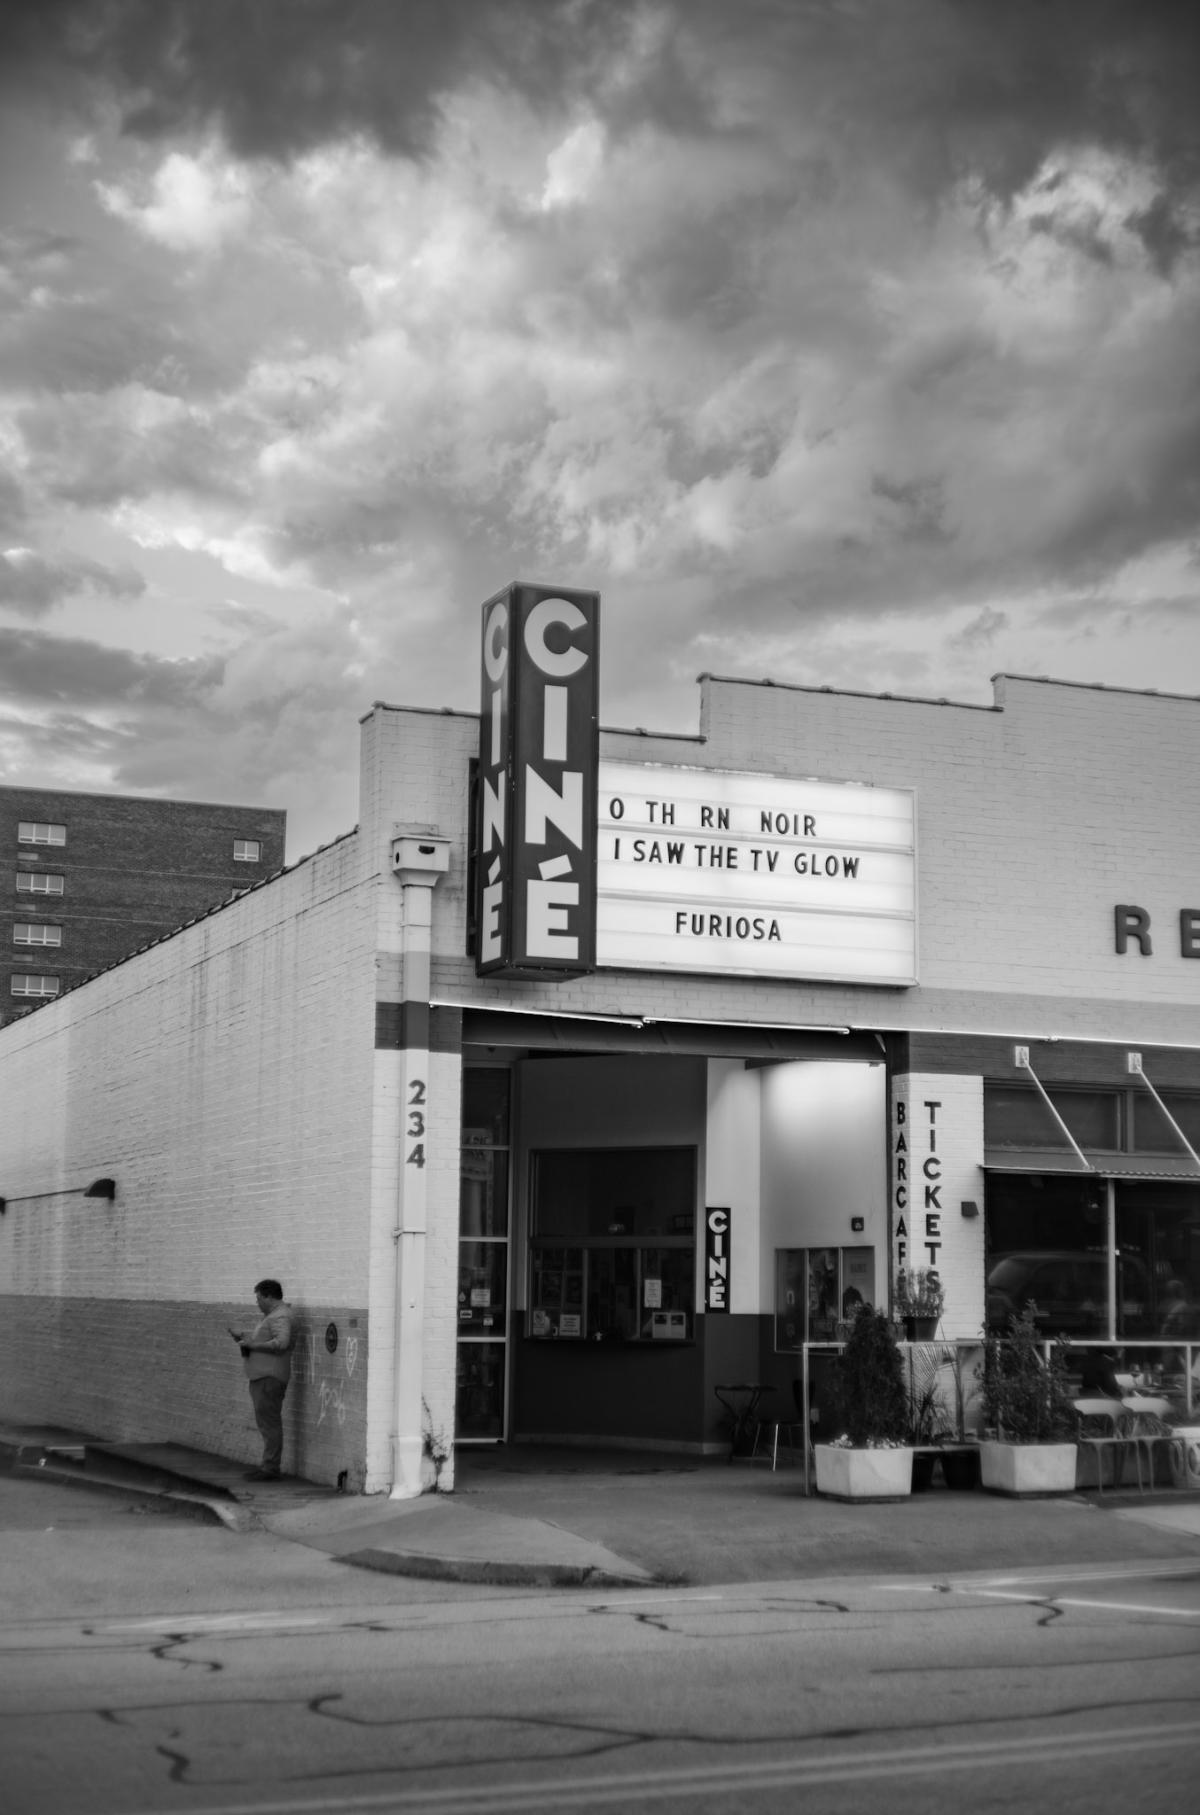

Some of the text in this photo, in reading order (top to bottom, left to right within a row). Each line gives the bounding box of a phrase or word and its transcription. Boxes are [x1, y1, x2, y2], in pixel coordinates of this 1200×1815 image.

[483, 602, 508, 963] CINÉ
[523, 597, 590, 961] CINÉ
[760, 810, 817, 837] NOIR
[613, 837, 860, 879] I SAW THE TV GLOW
[675, 911, 782, 941] FURIOSA
[407, 1080, 427, 1169] 234
[923, 1102, 942, 1293] TICKETS
[708, 1211, 728, 1308] CINÉ
